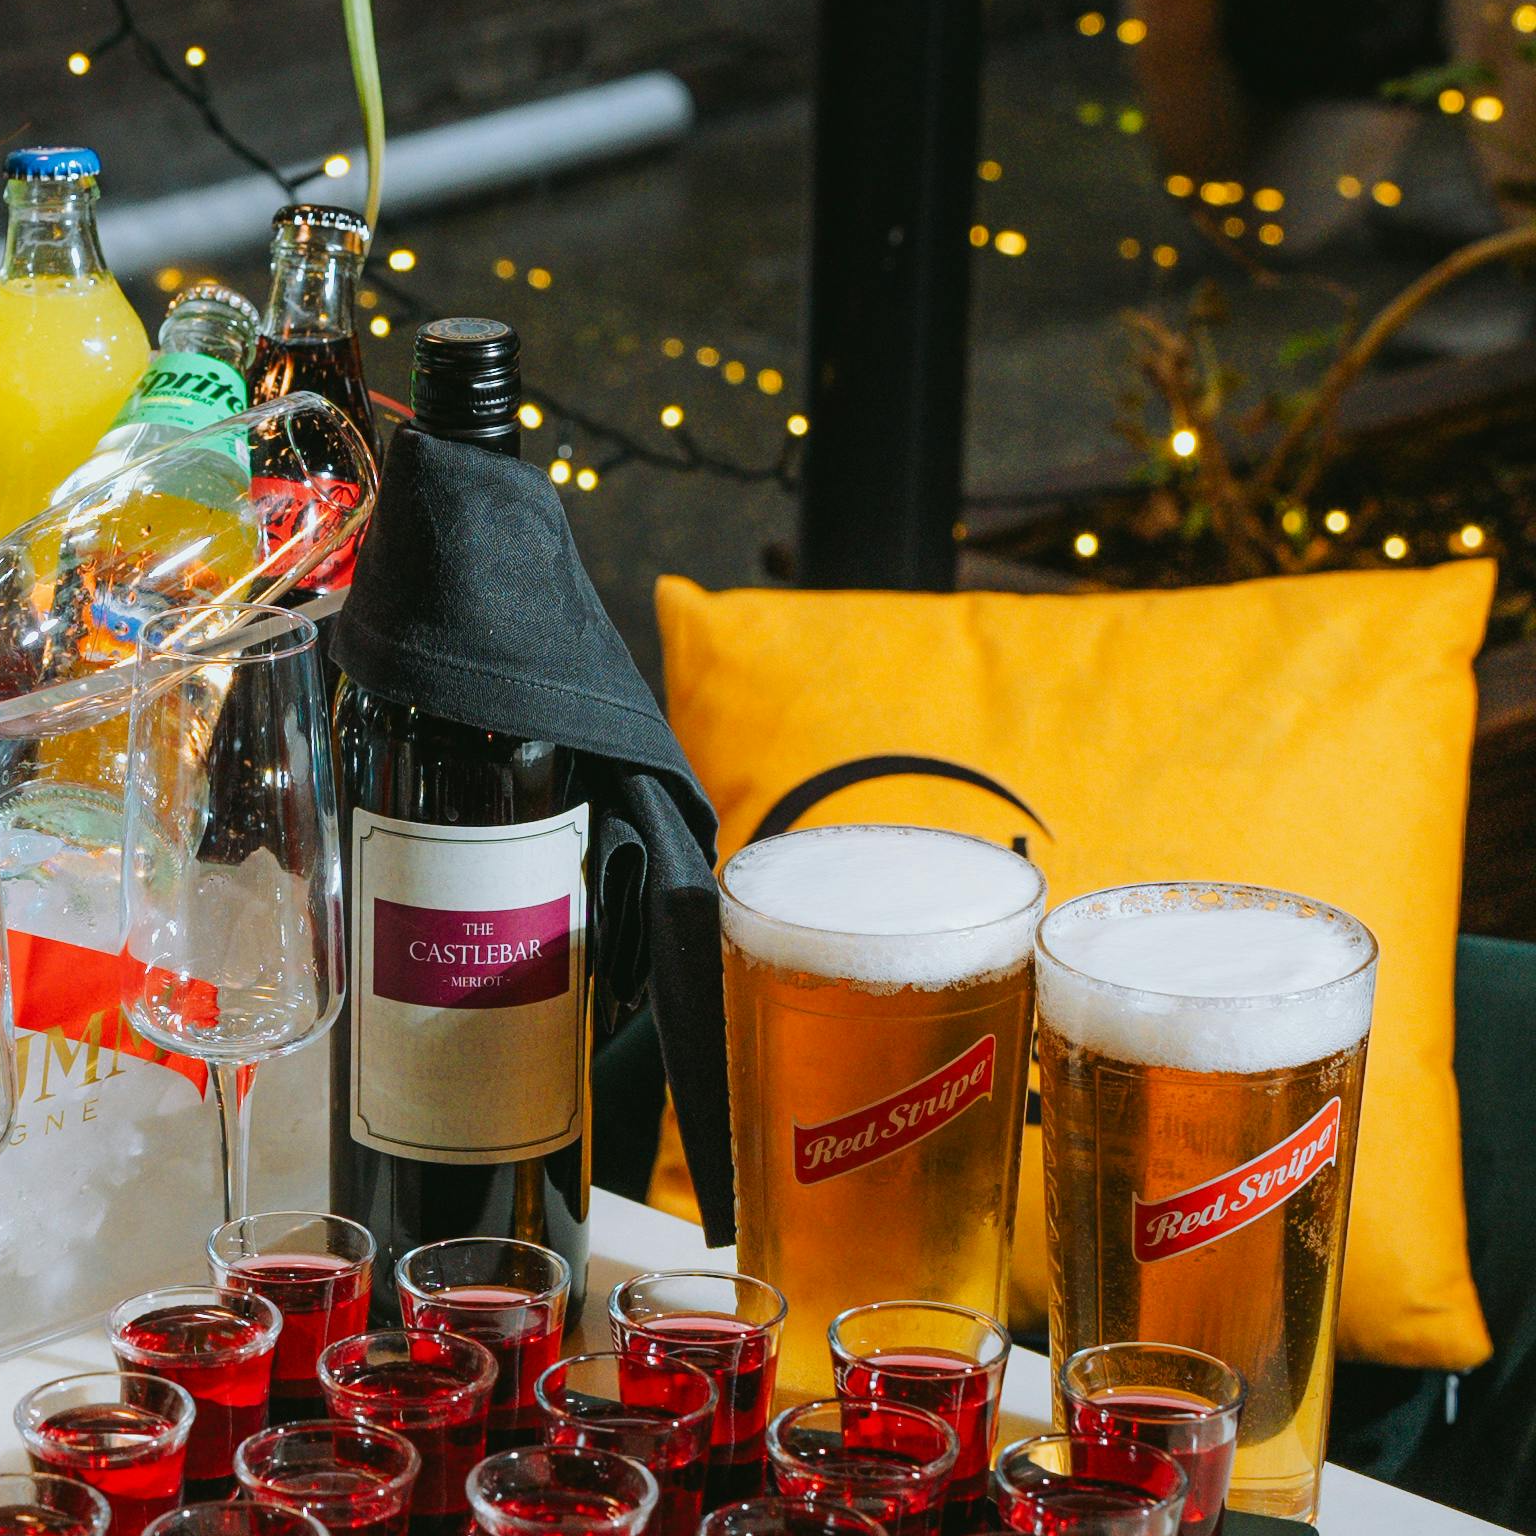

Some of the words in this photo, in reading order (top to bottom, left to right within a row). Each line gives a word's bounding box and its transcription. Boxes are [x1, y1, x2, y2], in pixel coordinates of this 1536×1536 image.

[176, 391, 216, 407] SUGAR
[462, 922, 494, 937] THE
[409, 939, 543, 966] CASTLEBAR
[450, 975, 504, 989] MERLOT
[802, 1121, 879, 1170] Red
[880, 1059, 987, 1139] Stripe
[1143, 1194, 1228, 1247] Red
[1230, 1123, 1334, 1212] Stripe
